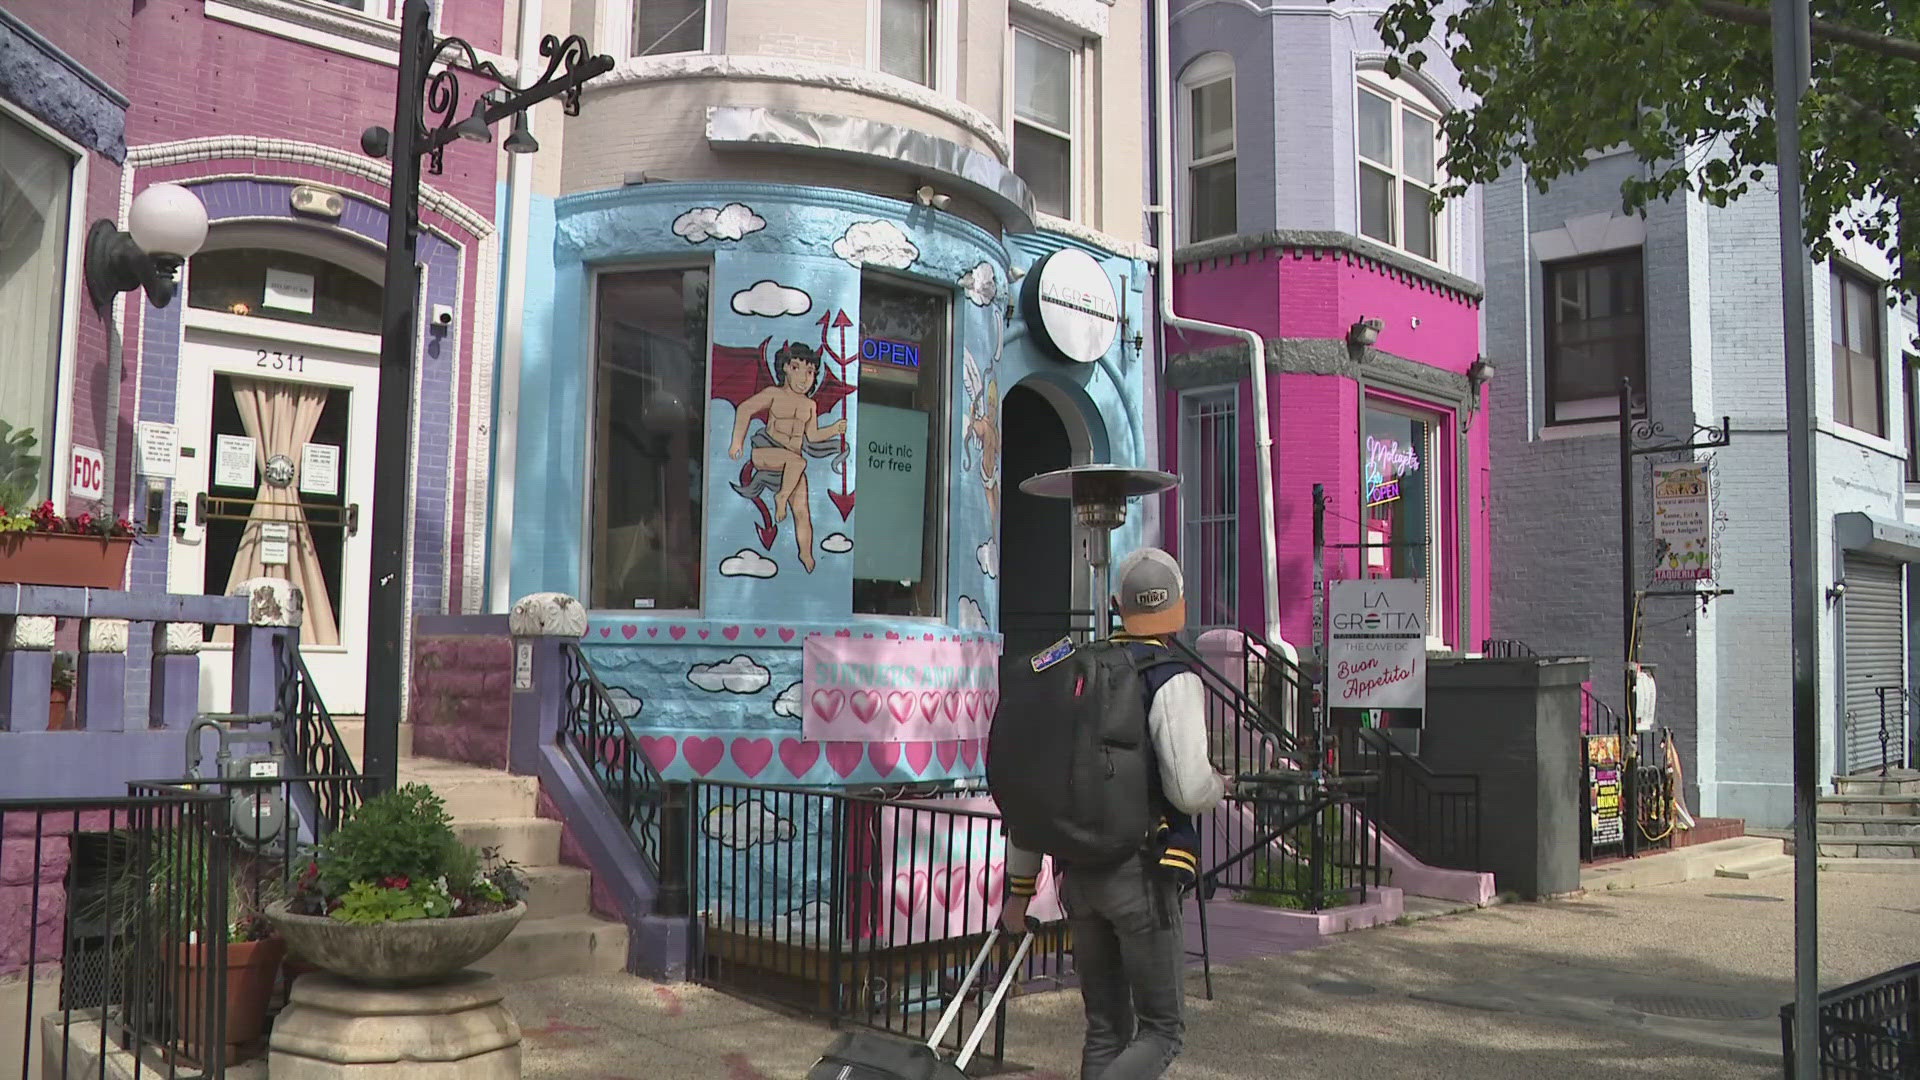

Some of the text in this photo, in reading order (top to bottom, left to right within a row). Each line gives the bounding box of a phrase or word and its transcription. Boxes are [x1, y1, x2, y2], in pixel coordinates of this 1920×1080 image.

[1041, 280, 1058, 298] LA
[256, 349, 304, 372] 2311
[862, 338, 919, 367] OPEN
[868, 440, 913, 458] Quit nic
[73, 454, 102, 491] FDC
[868, 455, 912, 472] for free
[1372, 483, 1400, 502] OPEN
[1364, 591, 1390, 609] LA
[1333, 612, 1420, 630] GROTTA
[1345, 642, 1409, 651] THE CAVE DC
[815, 662, 916, 688] SINNERS
[920, 664, 955, 689] AND
[1337, 658, 1379, 680] Buon
[1343, 657, 1415, 699] Appetito!
